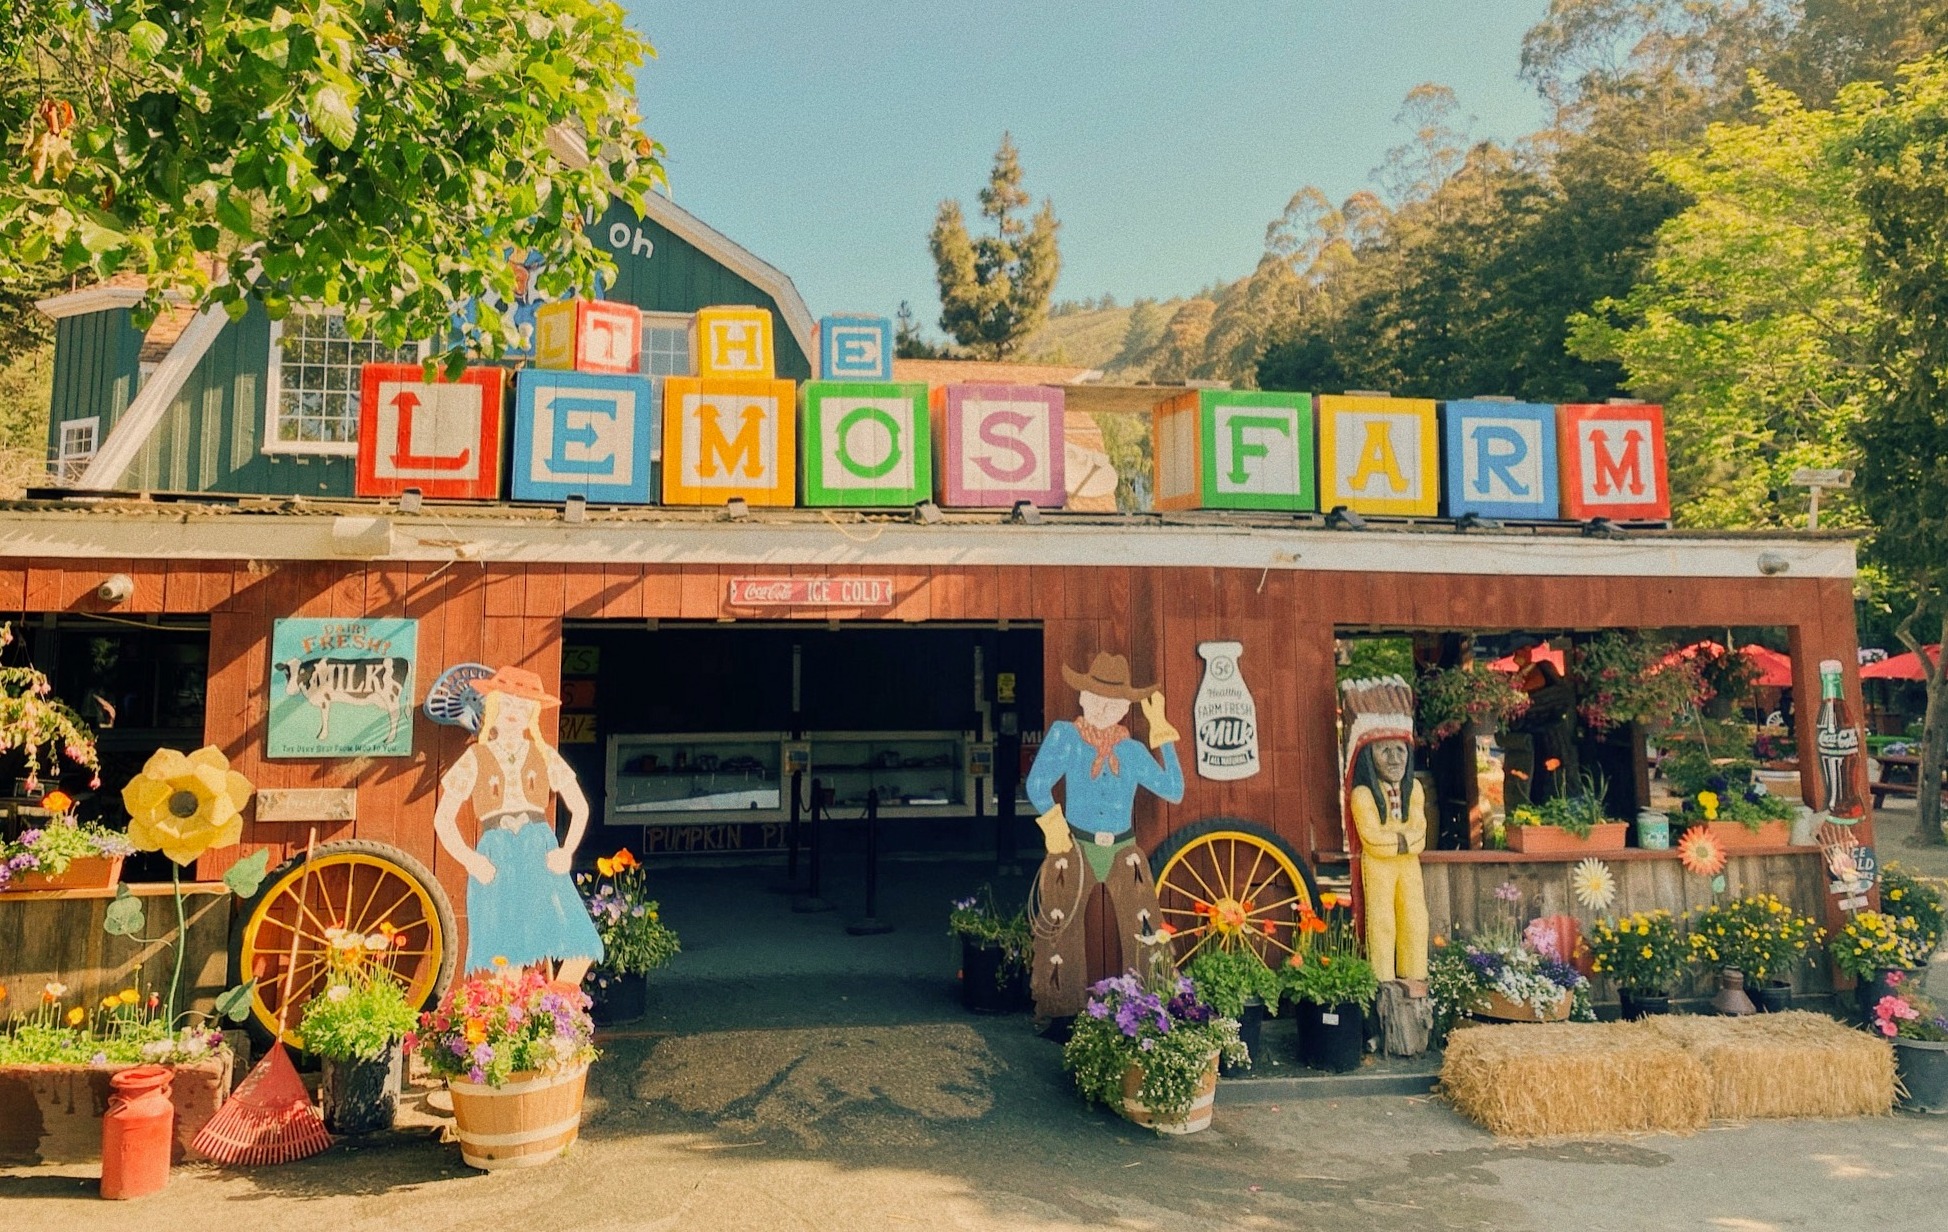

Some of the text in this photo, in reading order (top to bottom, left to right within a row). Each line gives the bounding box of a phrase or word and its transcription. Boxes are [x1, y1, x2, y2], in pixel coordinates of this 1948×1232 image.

[609, 222, 655, 259] Oh
[388, 390, 1645, 497] LEMOS FARM
[744, 581, 881, 602] Coca-Cola ICE COLD
[306, 663, 385, 693] MILK
[1198, 701, 1253, 719] FARM FRESH
[1201, 719, 1253, 747] Milk
[647, 823, 789, 851] PUMPKIN PI
[1851, 847, 1867, 858] CE
